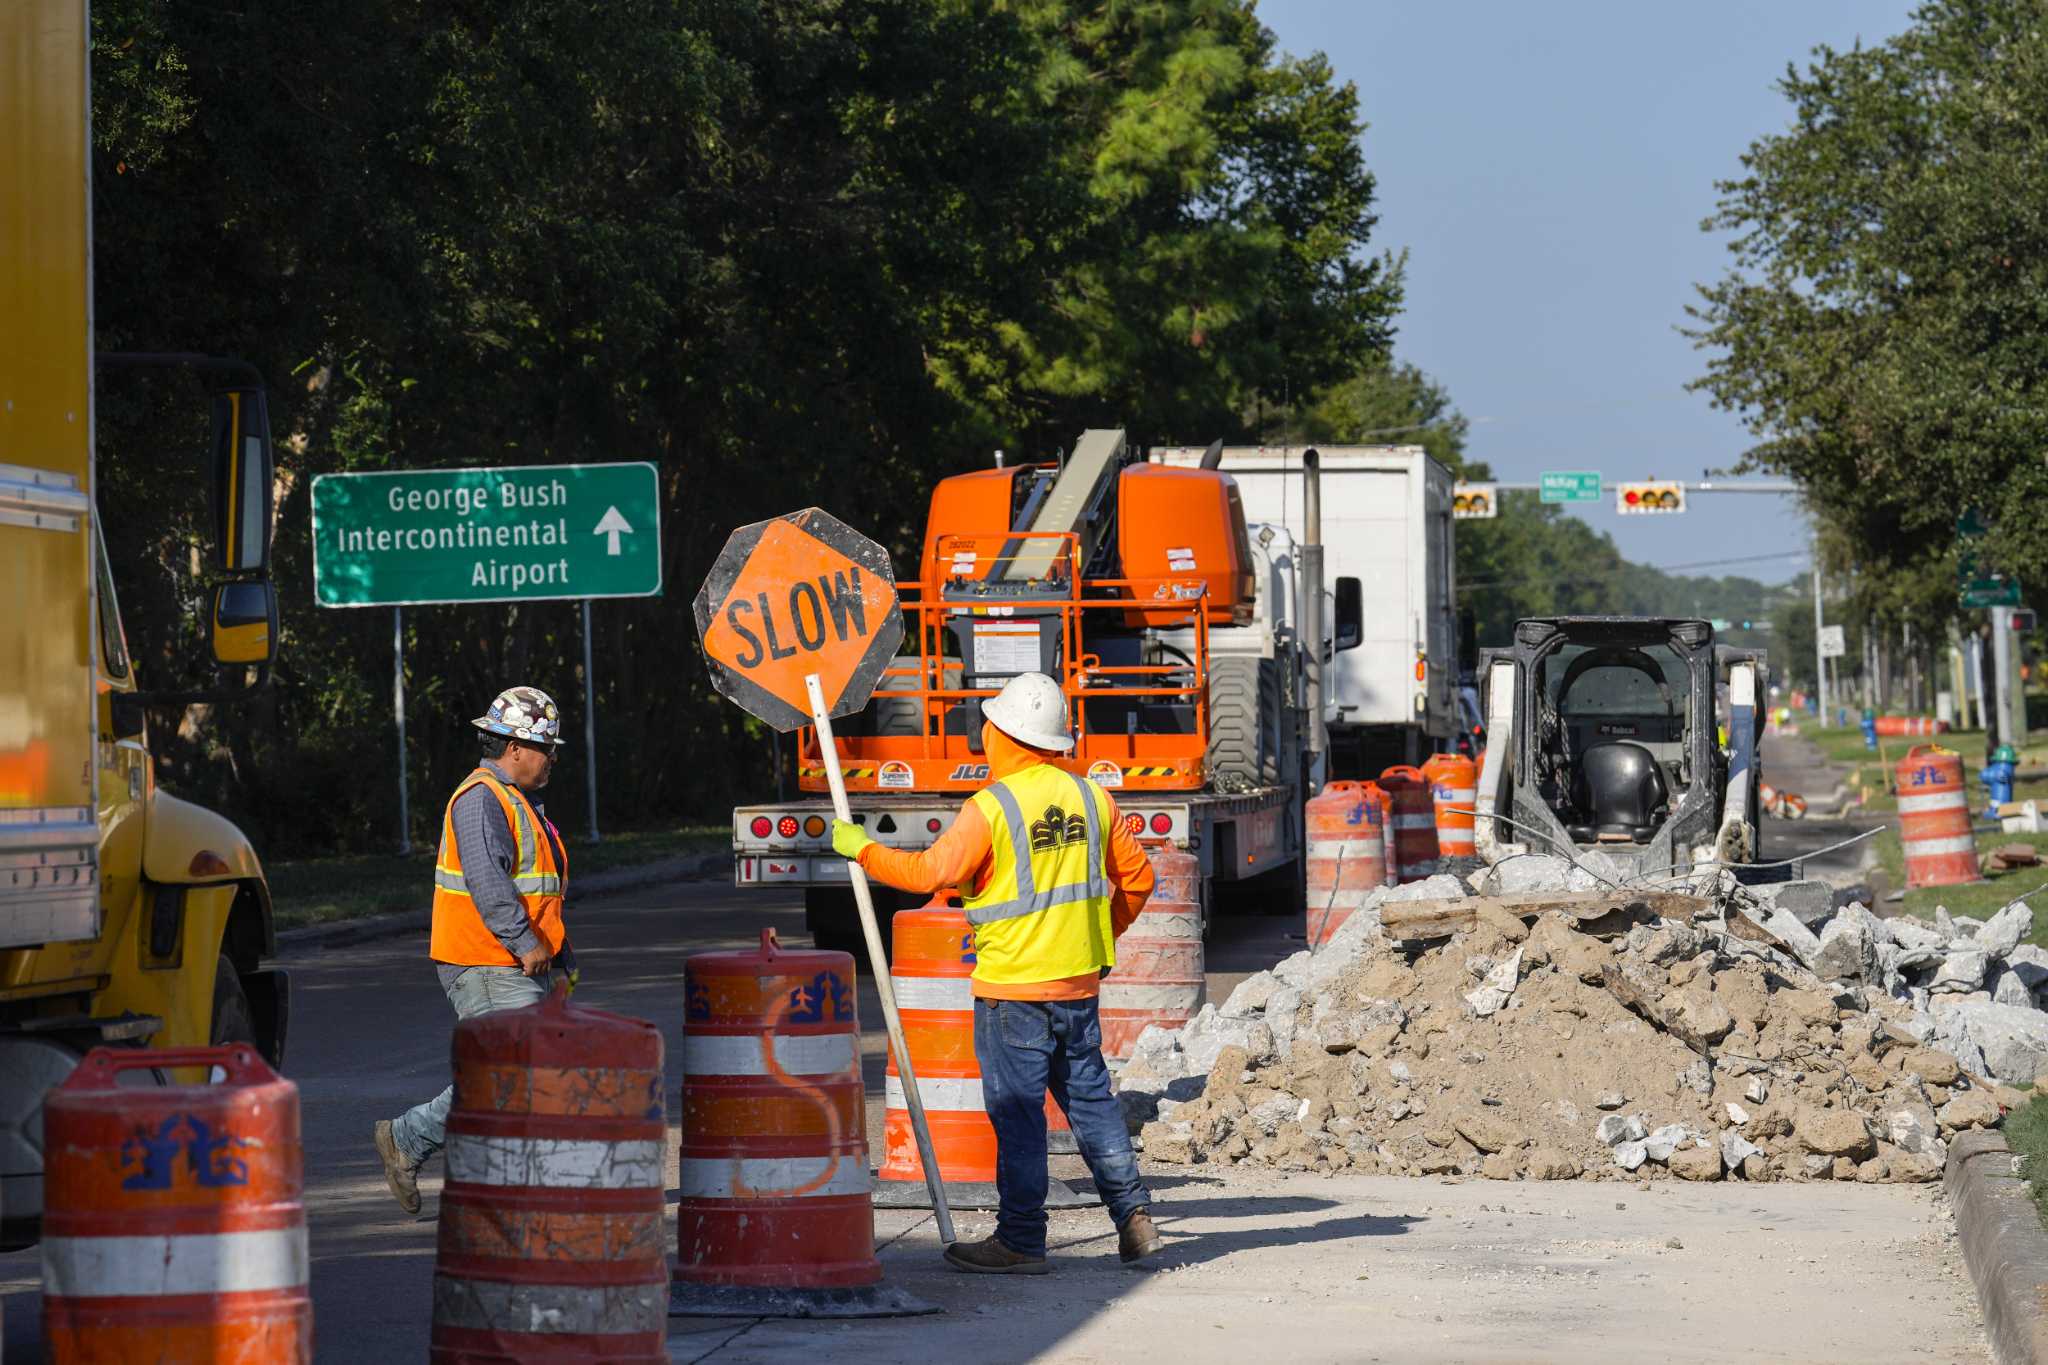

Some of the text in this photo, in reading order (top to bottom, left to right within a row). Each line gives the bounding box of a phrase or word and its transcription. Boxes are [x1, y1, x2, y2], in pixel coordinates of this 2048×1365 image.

[389, 479, 567, 515] George Bush
[339, 519, 568, 552] Intercontinental
[472, 559, 569, 591] Airport
[727, 566, 867, 669] SLOW
[949, 764, 990, 781] JLG
